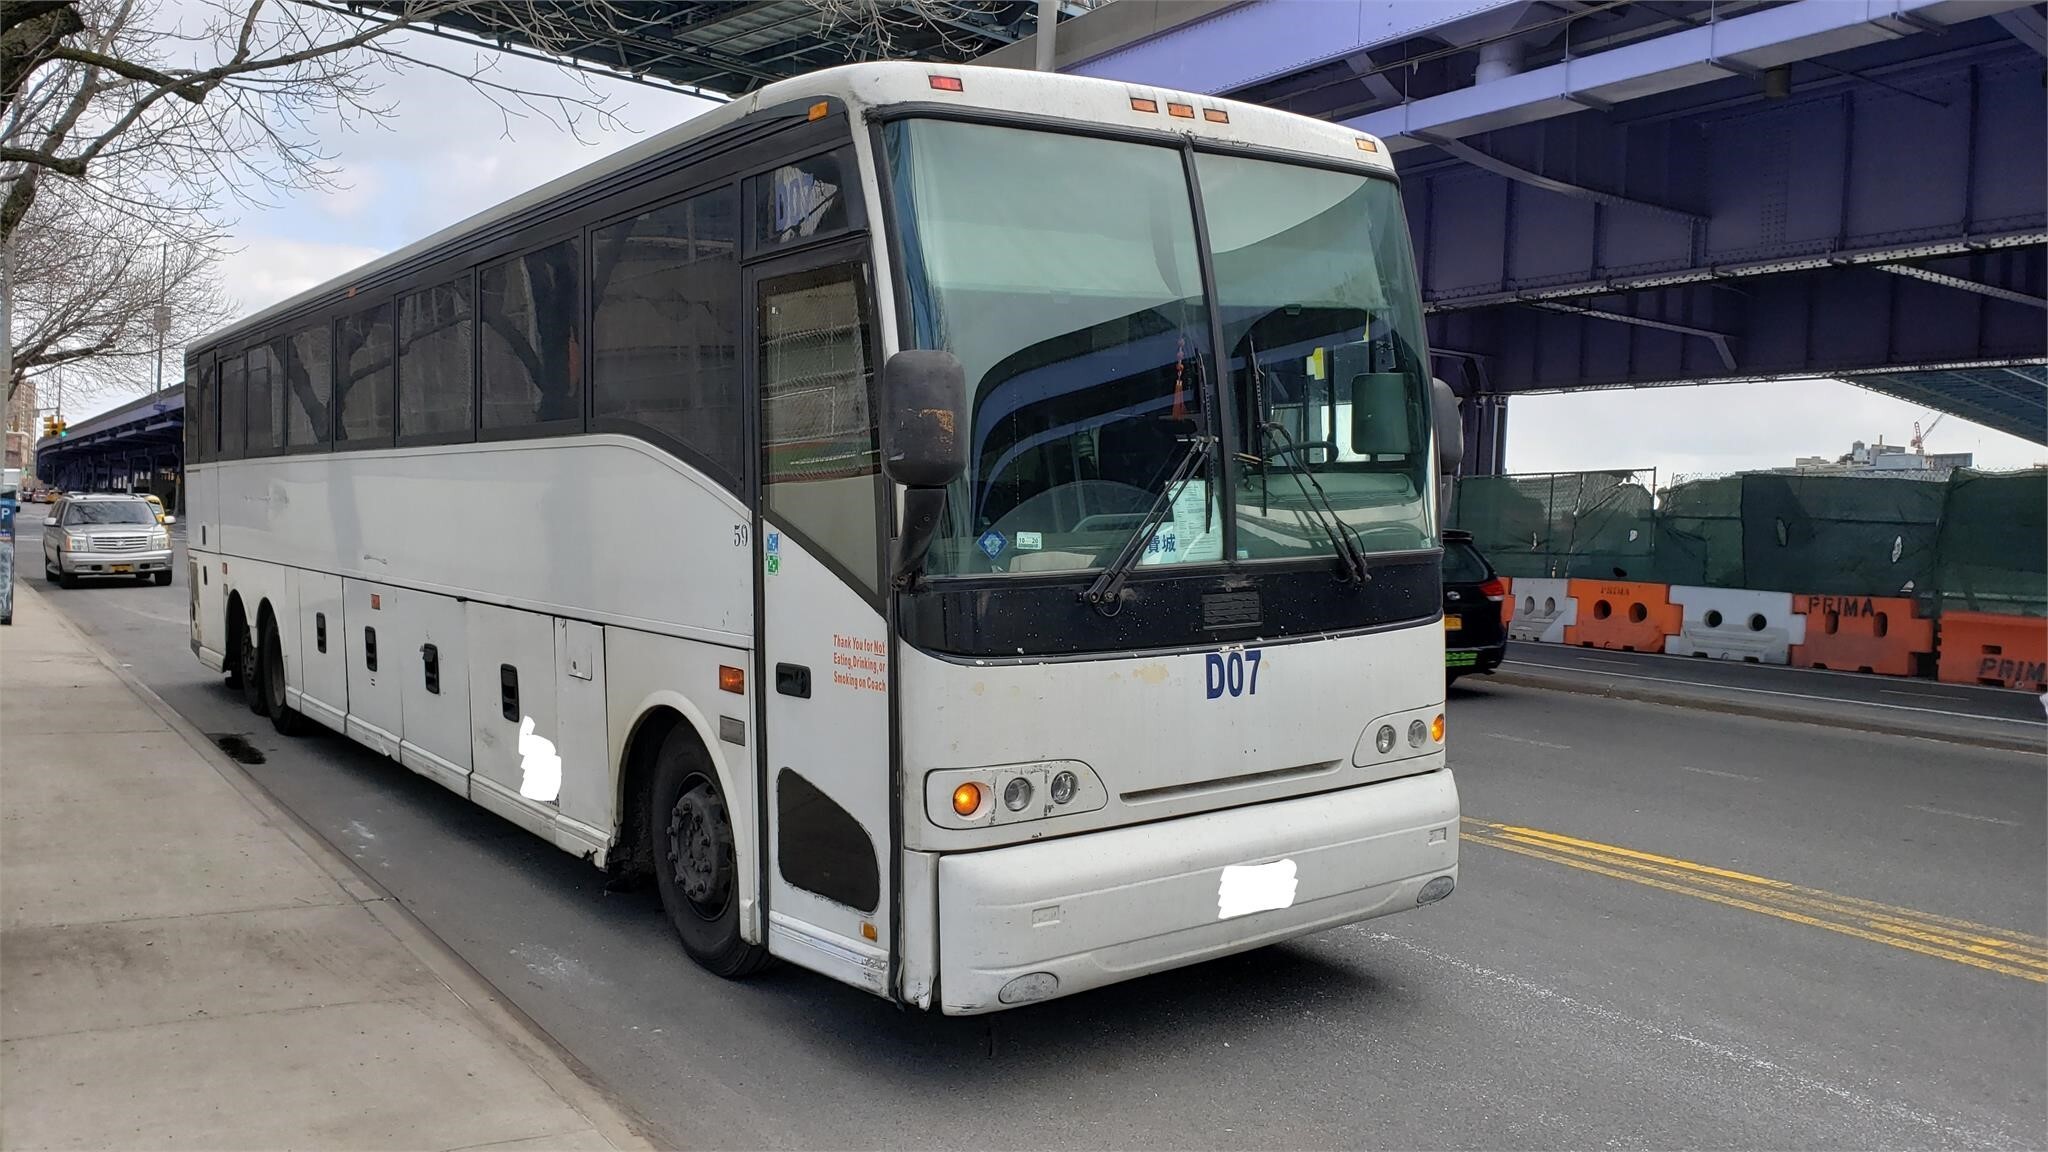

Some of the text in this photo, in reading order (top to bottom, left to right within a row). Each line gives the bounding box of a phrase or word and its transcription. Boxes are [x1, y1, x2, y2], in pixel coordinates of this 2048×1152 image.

[734, 524, 748, 547] 59
[1808, 596, 1874, 618] PRIMA
[833, 634, 886, 657] Thank You for Not
[852, 655, 879, 675] Drinking,
[879, 662, 886, 673] or
[1206, 650, 1261, 700] D07
[833, 670, 887, 693] Smoking on Coach
